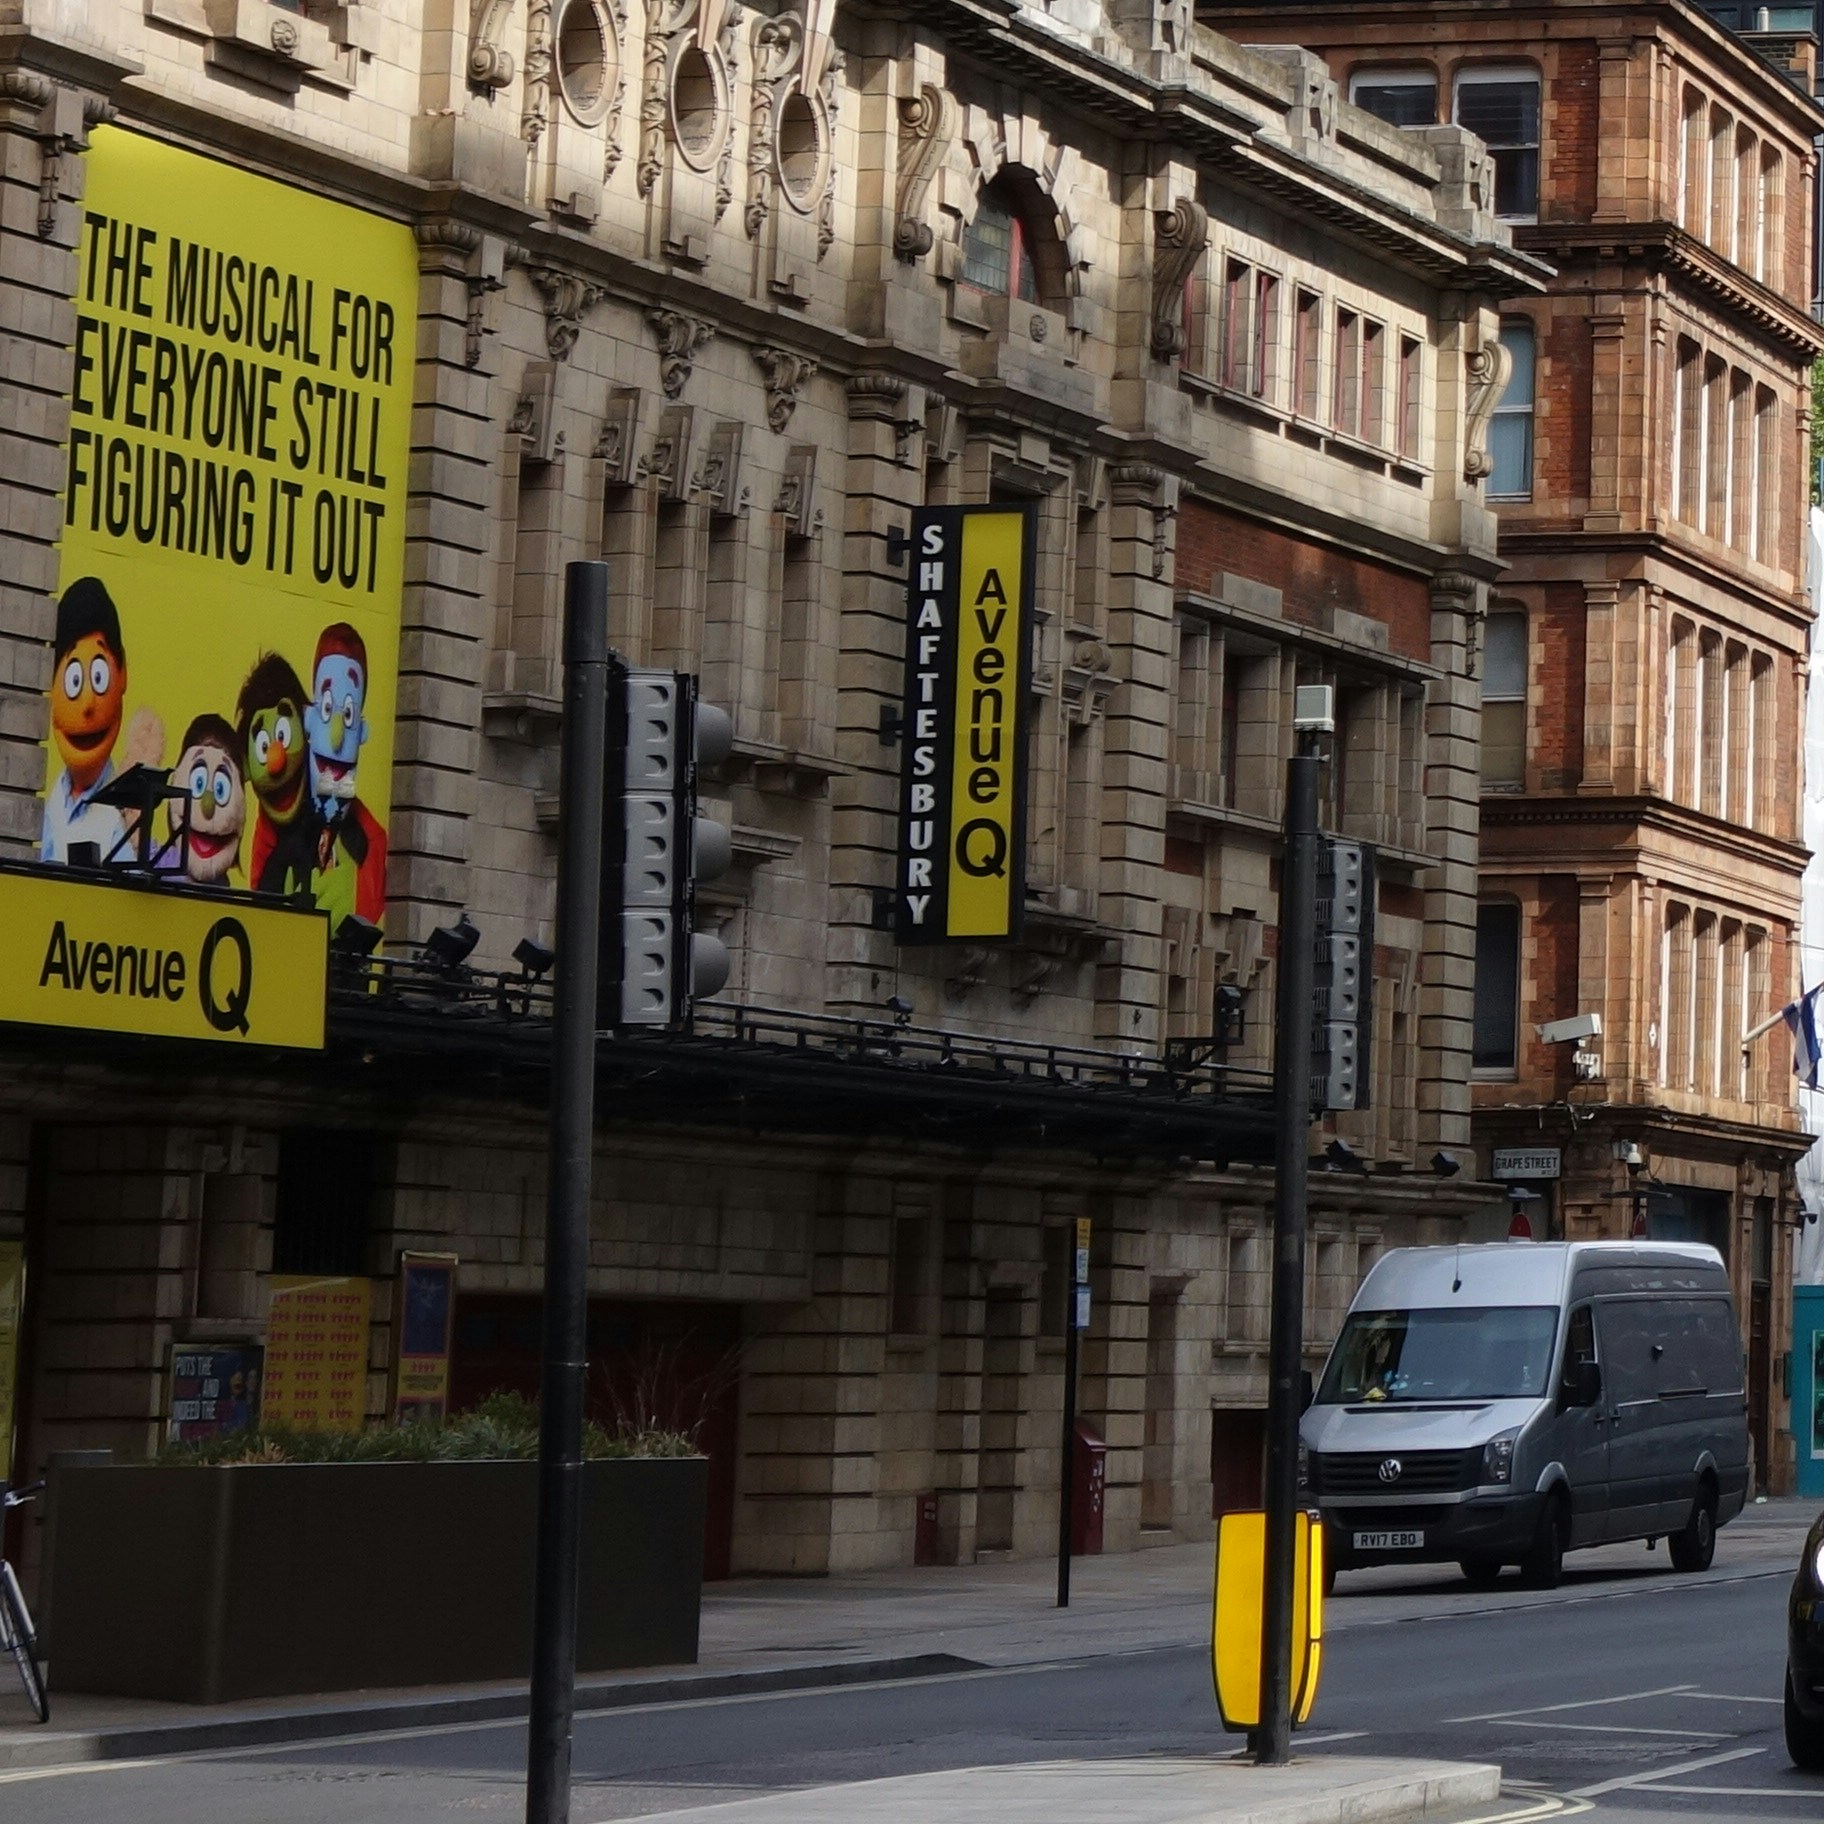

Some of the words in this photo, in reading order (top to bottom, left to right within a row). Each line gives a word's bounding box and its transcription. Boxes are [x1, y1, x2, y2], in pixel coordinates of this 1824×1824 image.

[84, 212, 155, 317] THE
[168, 241, 320, 365] MUSICAL
[331, 289, 393, 386] FOR
[73, 317, 281, 462] EVERYONE
[291, 381, 386, 489] STILL
[66, 428, 255, 566] FIGURING
[268, 477, 303, 576] IT
[313, 490, 386, 593] OUT
[906, 524, 944, 926] SHAFTESBURY
[967, 568, 1006, 804] Avenue
[955, 818, 1006, 879] Q
[40, 920, 185, 1001] Avenue
[198, 916, 252, 1037] Q
[1495, 1157, 1523, 1169] GRAPE
[1524, 1157, 1557, 1169] STREET
[1361, 1534, 1387, 1546] RV17
